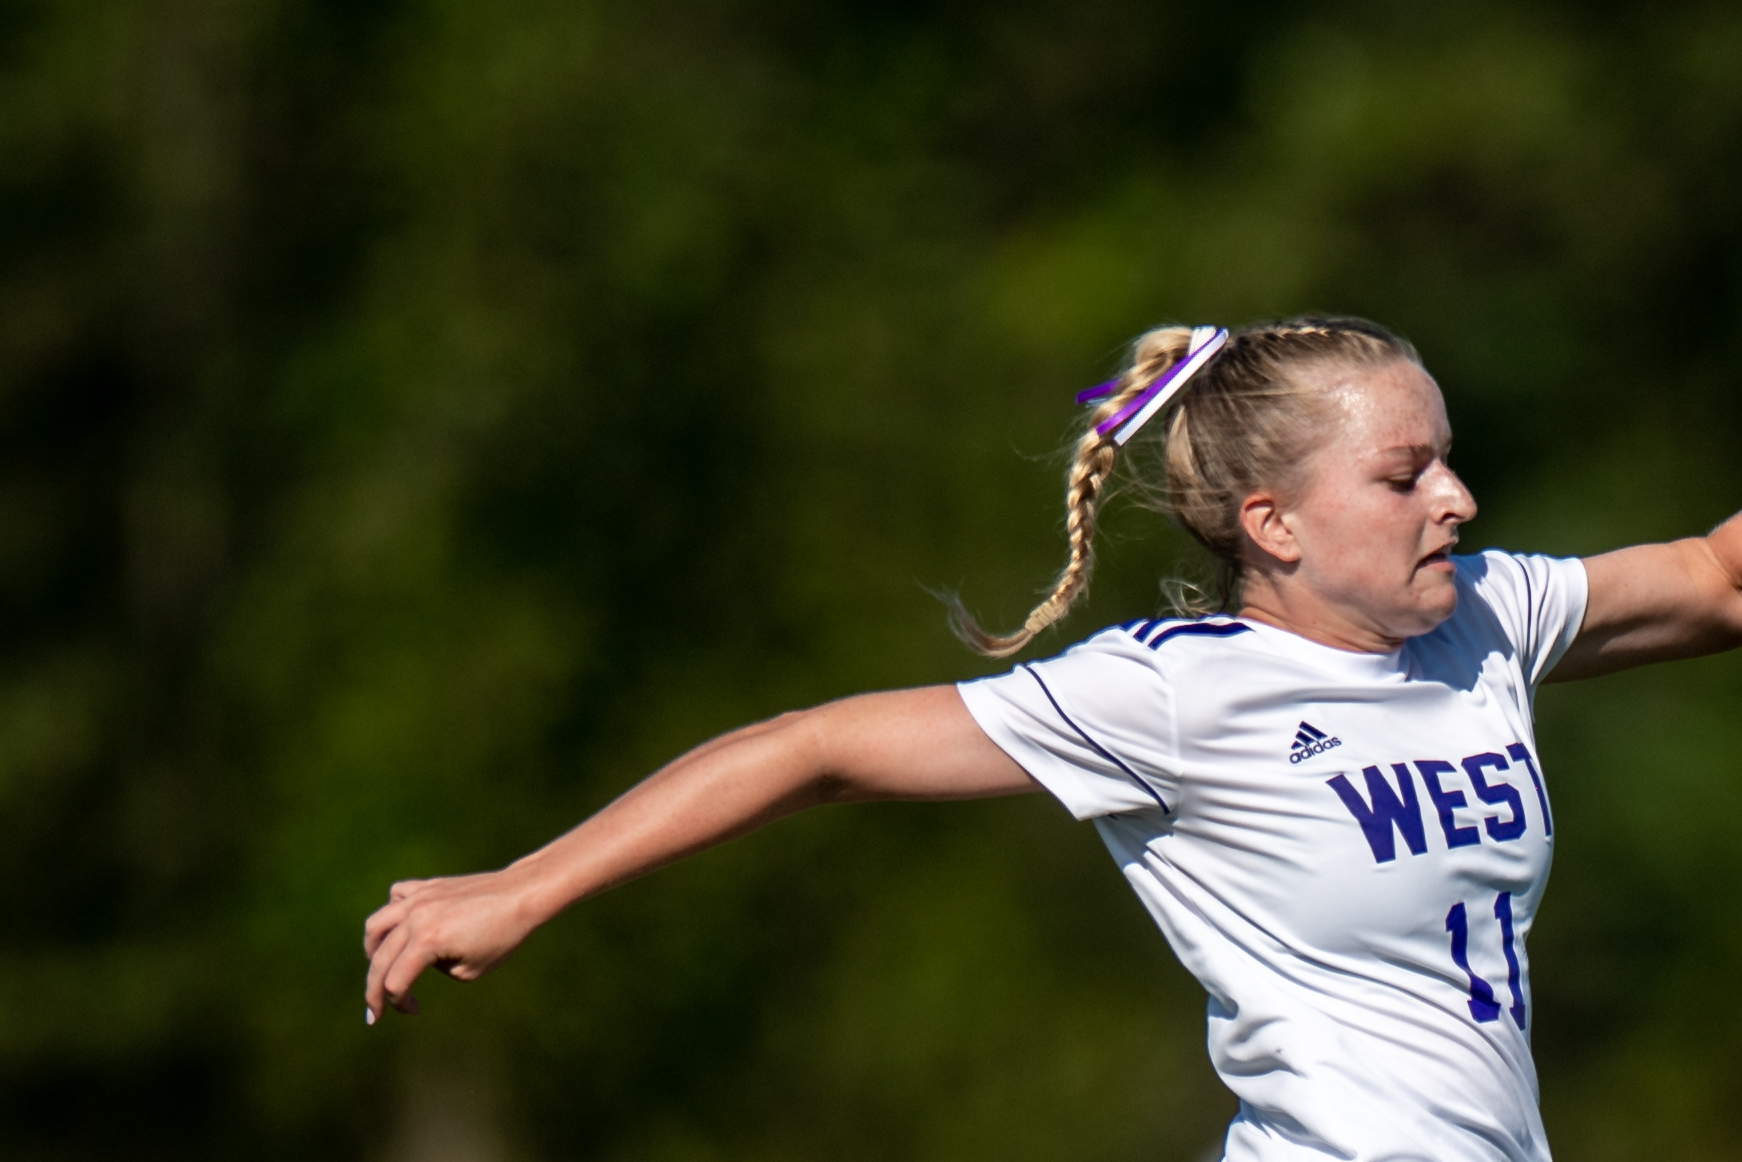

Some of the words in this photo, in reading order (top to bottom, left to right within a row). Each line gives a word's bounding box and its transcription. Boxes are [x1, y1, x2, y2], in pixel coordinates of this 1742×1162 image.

[1289, 735, 1342, 765] adidas
[1325, 742, 1553, 864] WEST
[1445, 891, 1527, 1032] 11
